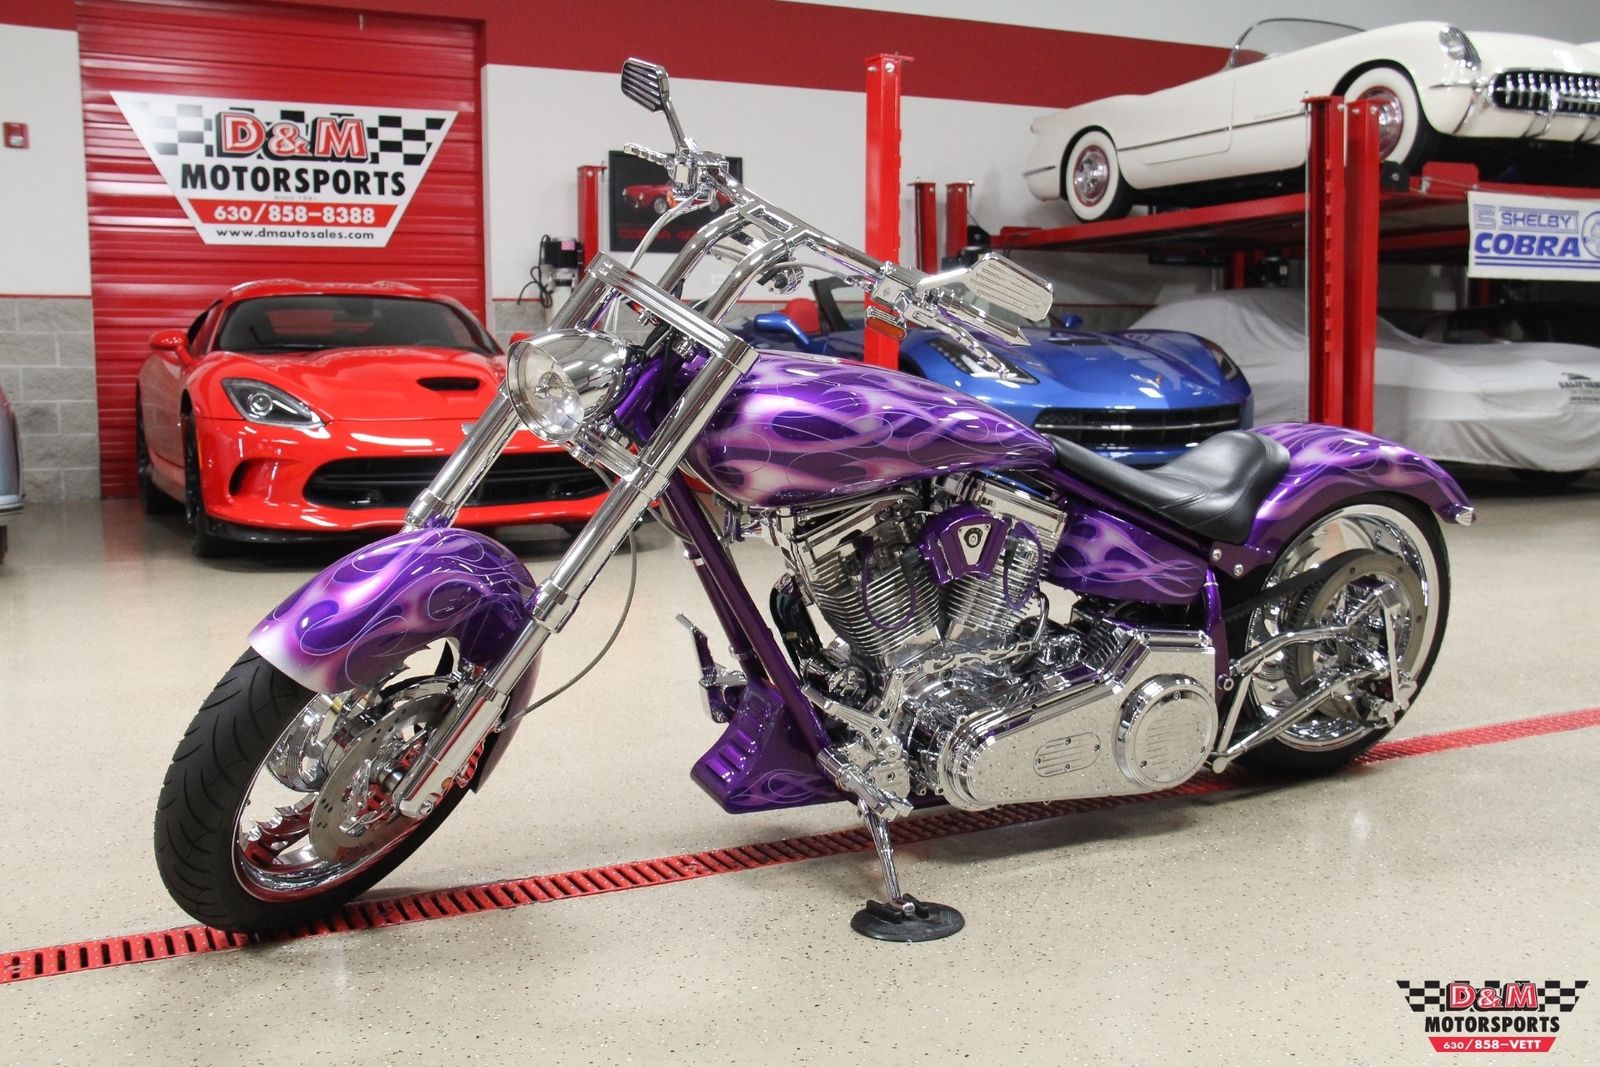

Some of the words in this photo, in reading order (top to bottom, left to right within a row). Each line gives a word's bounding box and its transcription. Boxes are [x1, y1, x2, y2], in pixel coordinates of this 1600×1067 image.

[218, 112, 368, 162] D&M
[181, 164, 406, 196] MOTORSPORTS
[1501, 212, 1572, 228] SHELBY
[216, 228, 375, 240] www.dmautosales.com
[1474, 232, 1580, 257] COBRA
